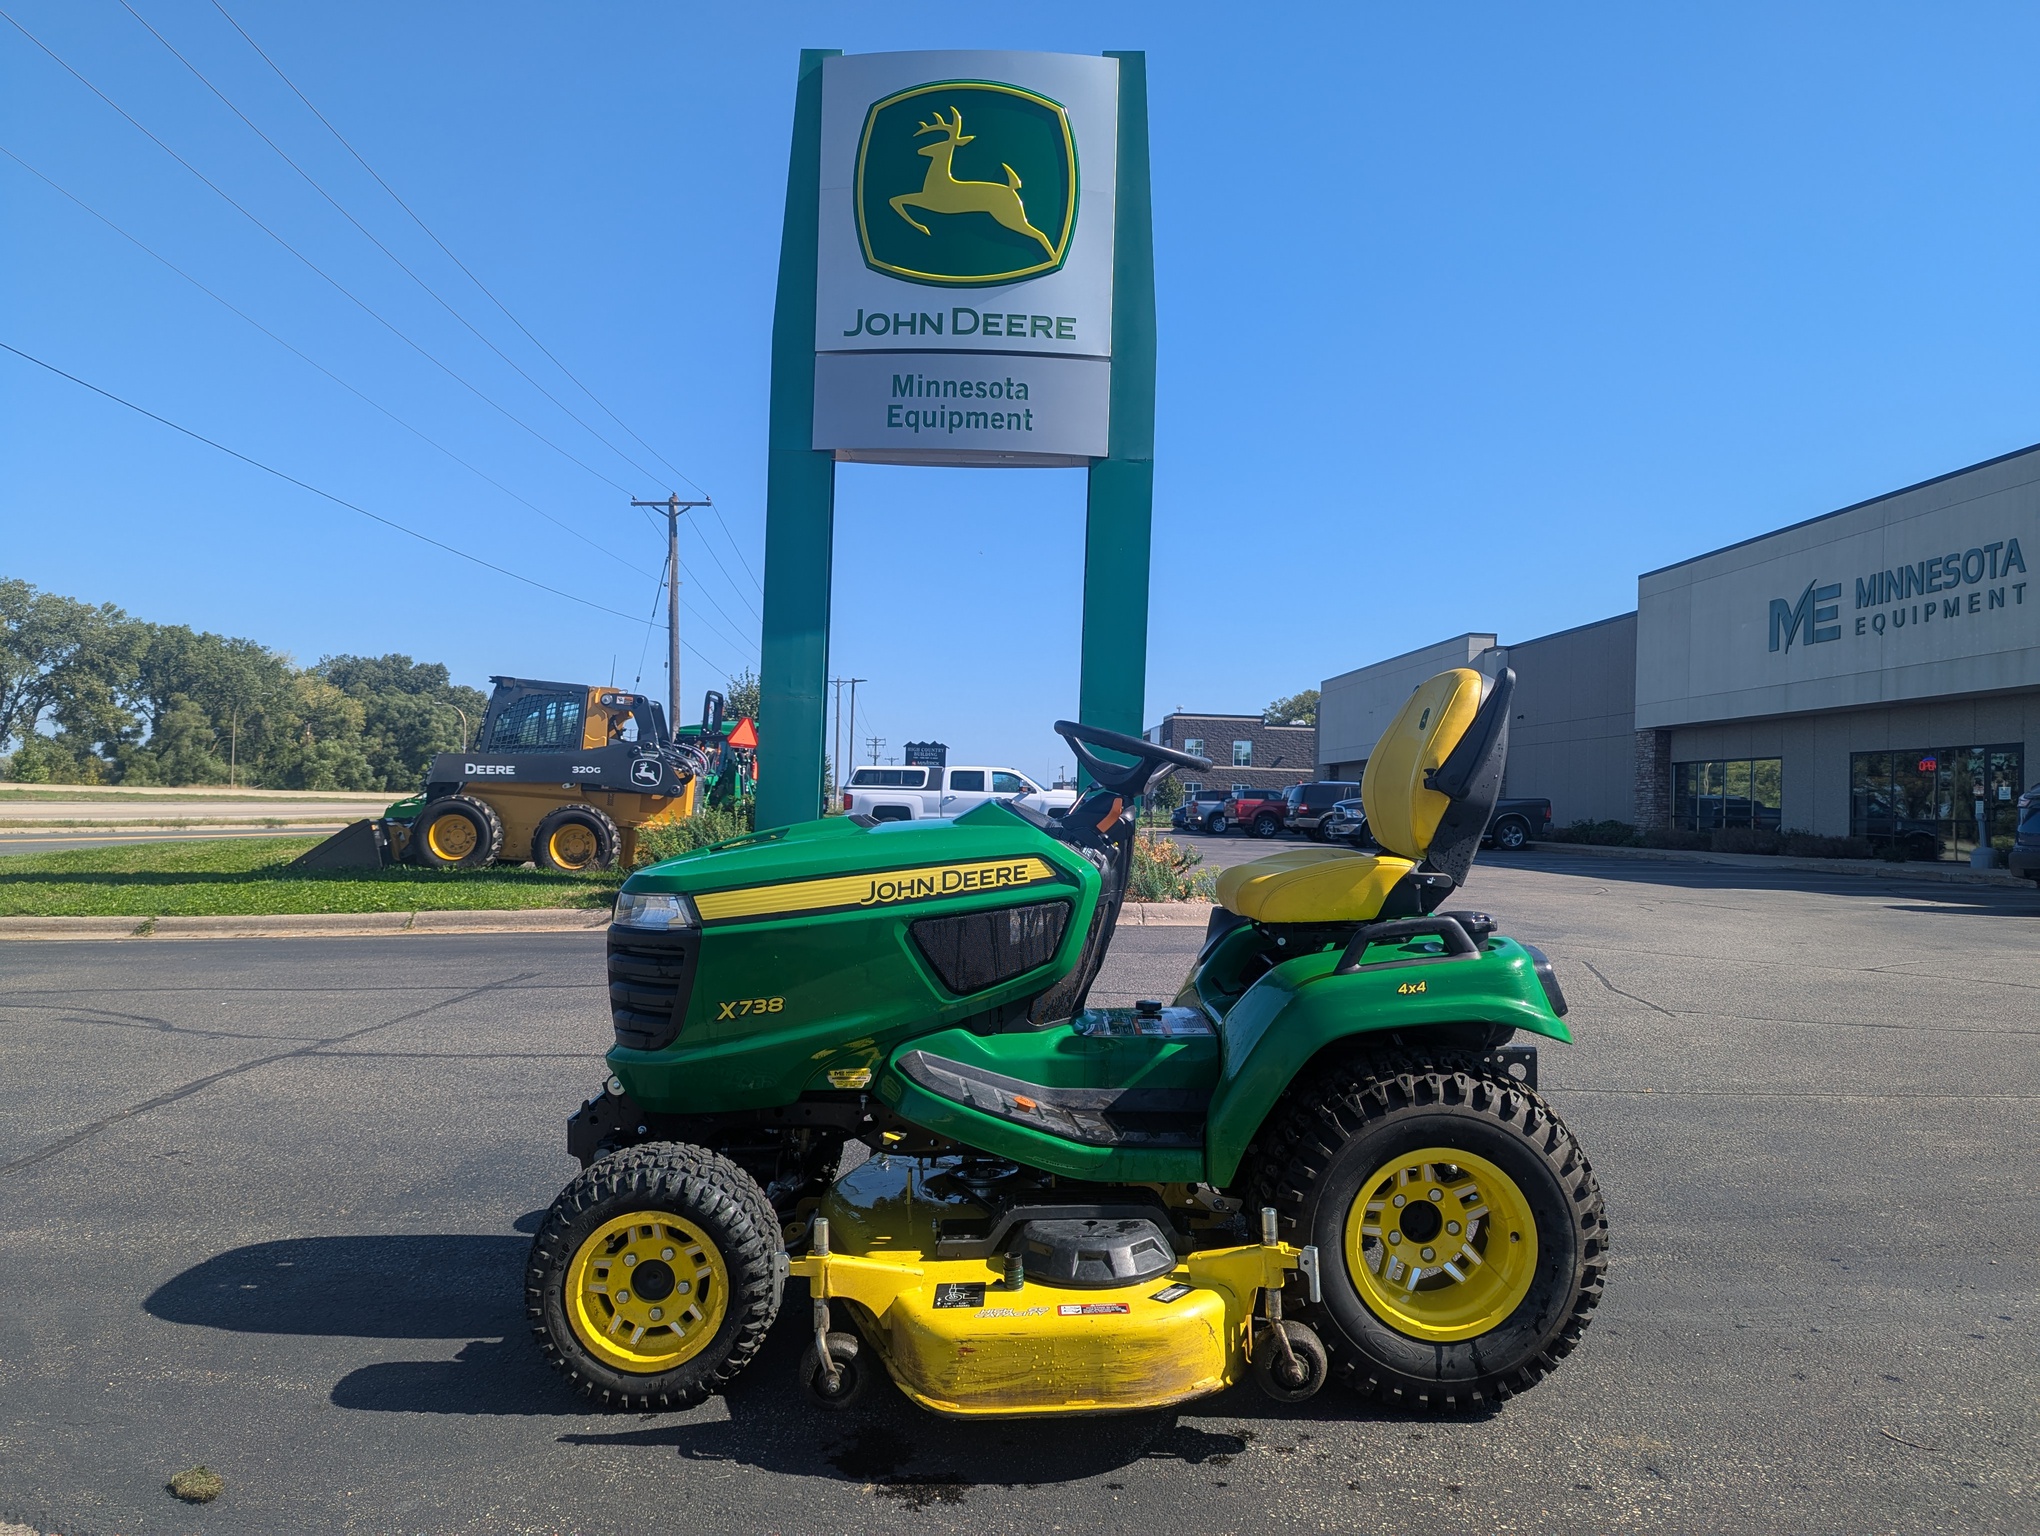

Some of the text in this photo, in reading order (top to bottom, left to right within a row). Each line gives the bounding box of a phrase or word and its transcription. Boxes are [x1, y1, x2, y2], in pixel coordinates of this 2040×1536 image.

[843, 307, 1077, 340] JOHN DEERE
[891, 374, 1030, 401] Minnesota
[886, 404, 1033, 434] Equipment
[1855, 537, 2027, 610] MINNESOTA
[1855, 582, 2027, 636] EQUIPMENT
[464, 763, 516, 775] DEERE
[571, 765, 602, 774] 320G
[860, 864, 1029, 903] JOHN DEERE
[1397, 981, 1427, 995] 4x4
[716, 997, 785, 1021] X738
